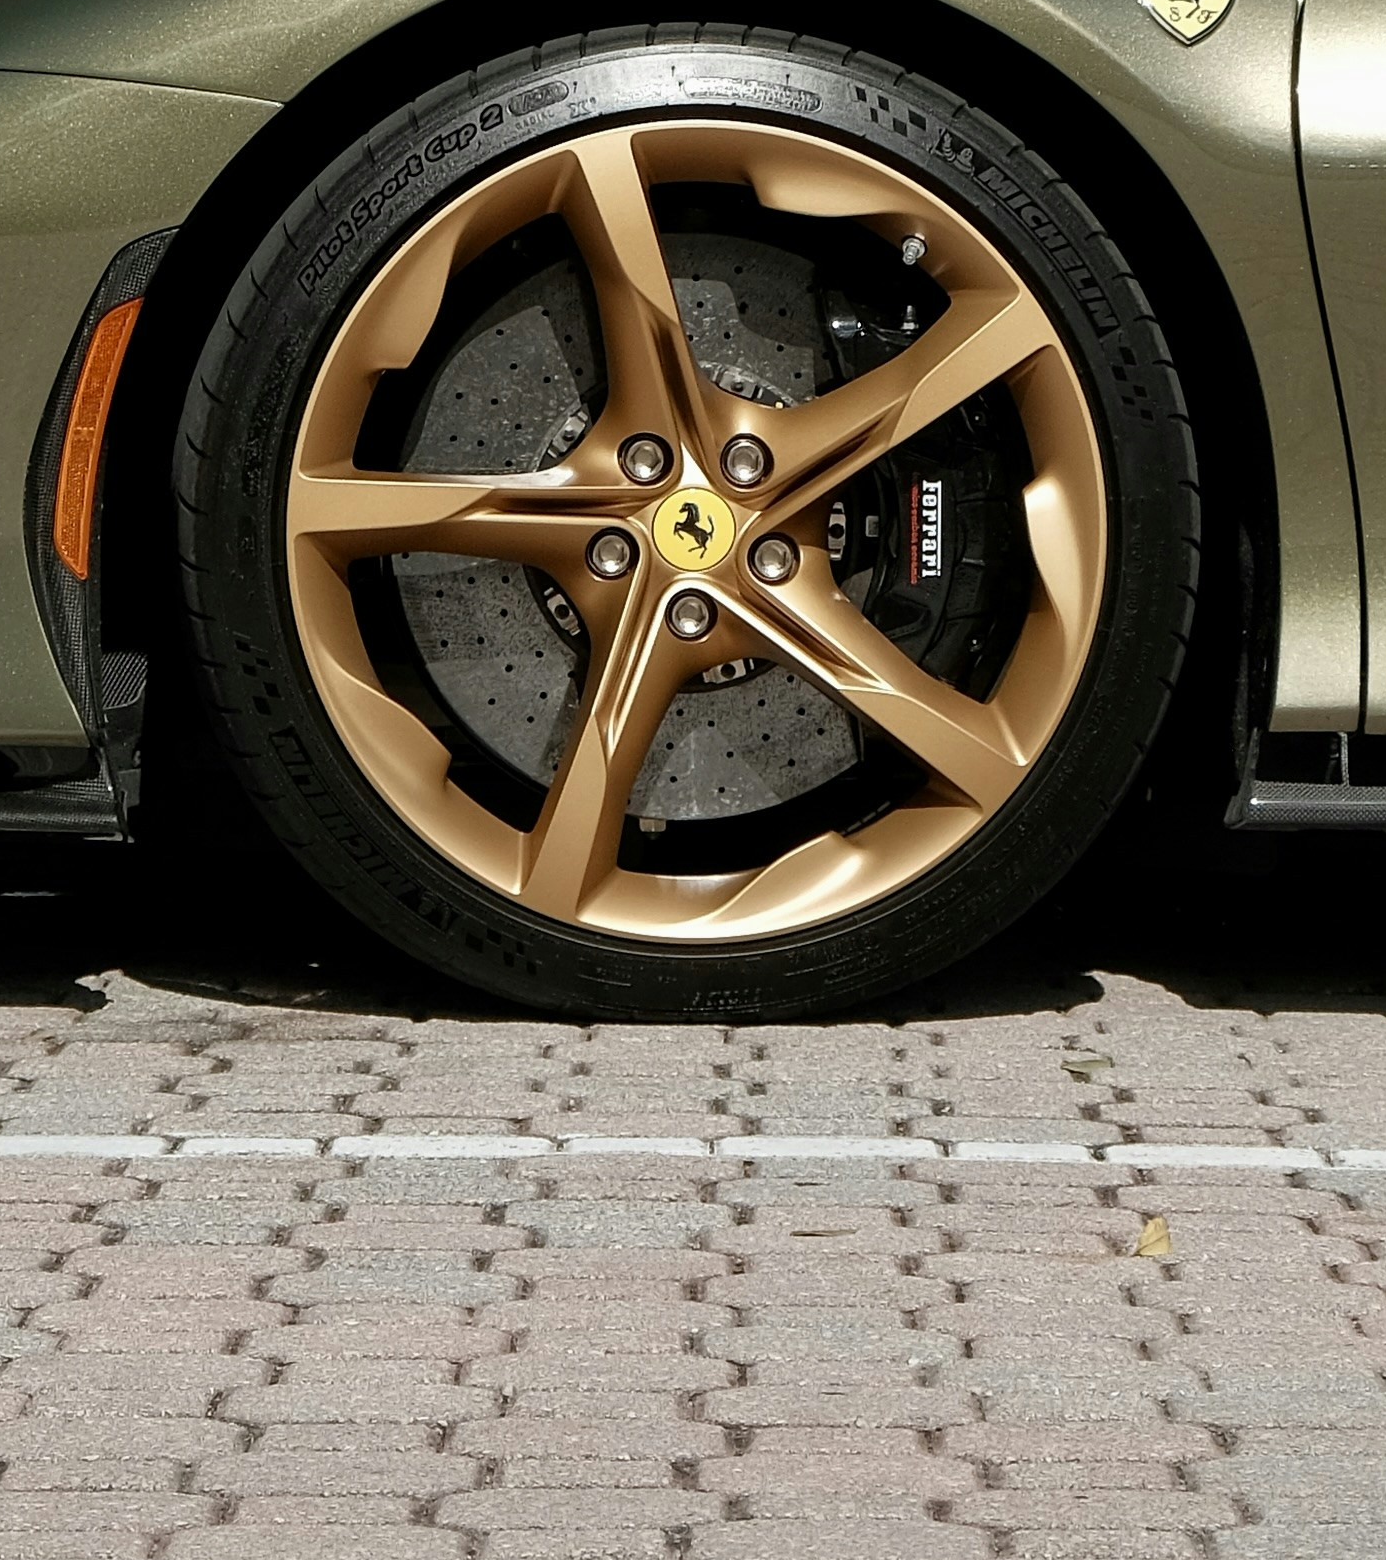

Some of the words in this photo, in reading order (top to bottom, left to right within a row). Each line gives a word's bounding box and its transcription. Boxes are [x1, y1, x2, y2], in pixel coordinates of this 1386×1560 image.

[298, 214, 355, 298] Pilot
[349, 154, 425, 231] Sport
[423, 122, 478, 164] Cup
[479, 102, 504, 132] 2
[976, 166, 1121, 331] MICHELIN
[922, 479, 942, 578] Ferrari
[268, 729, 411, 898] MICHELIN
